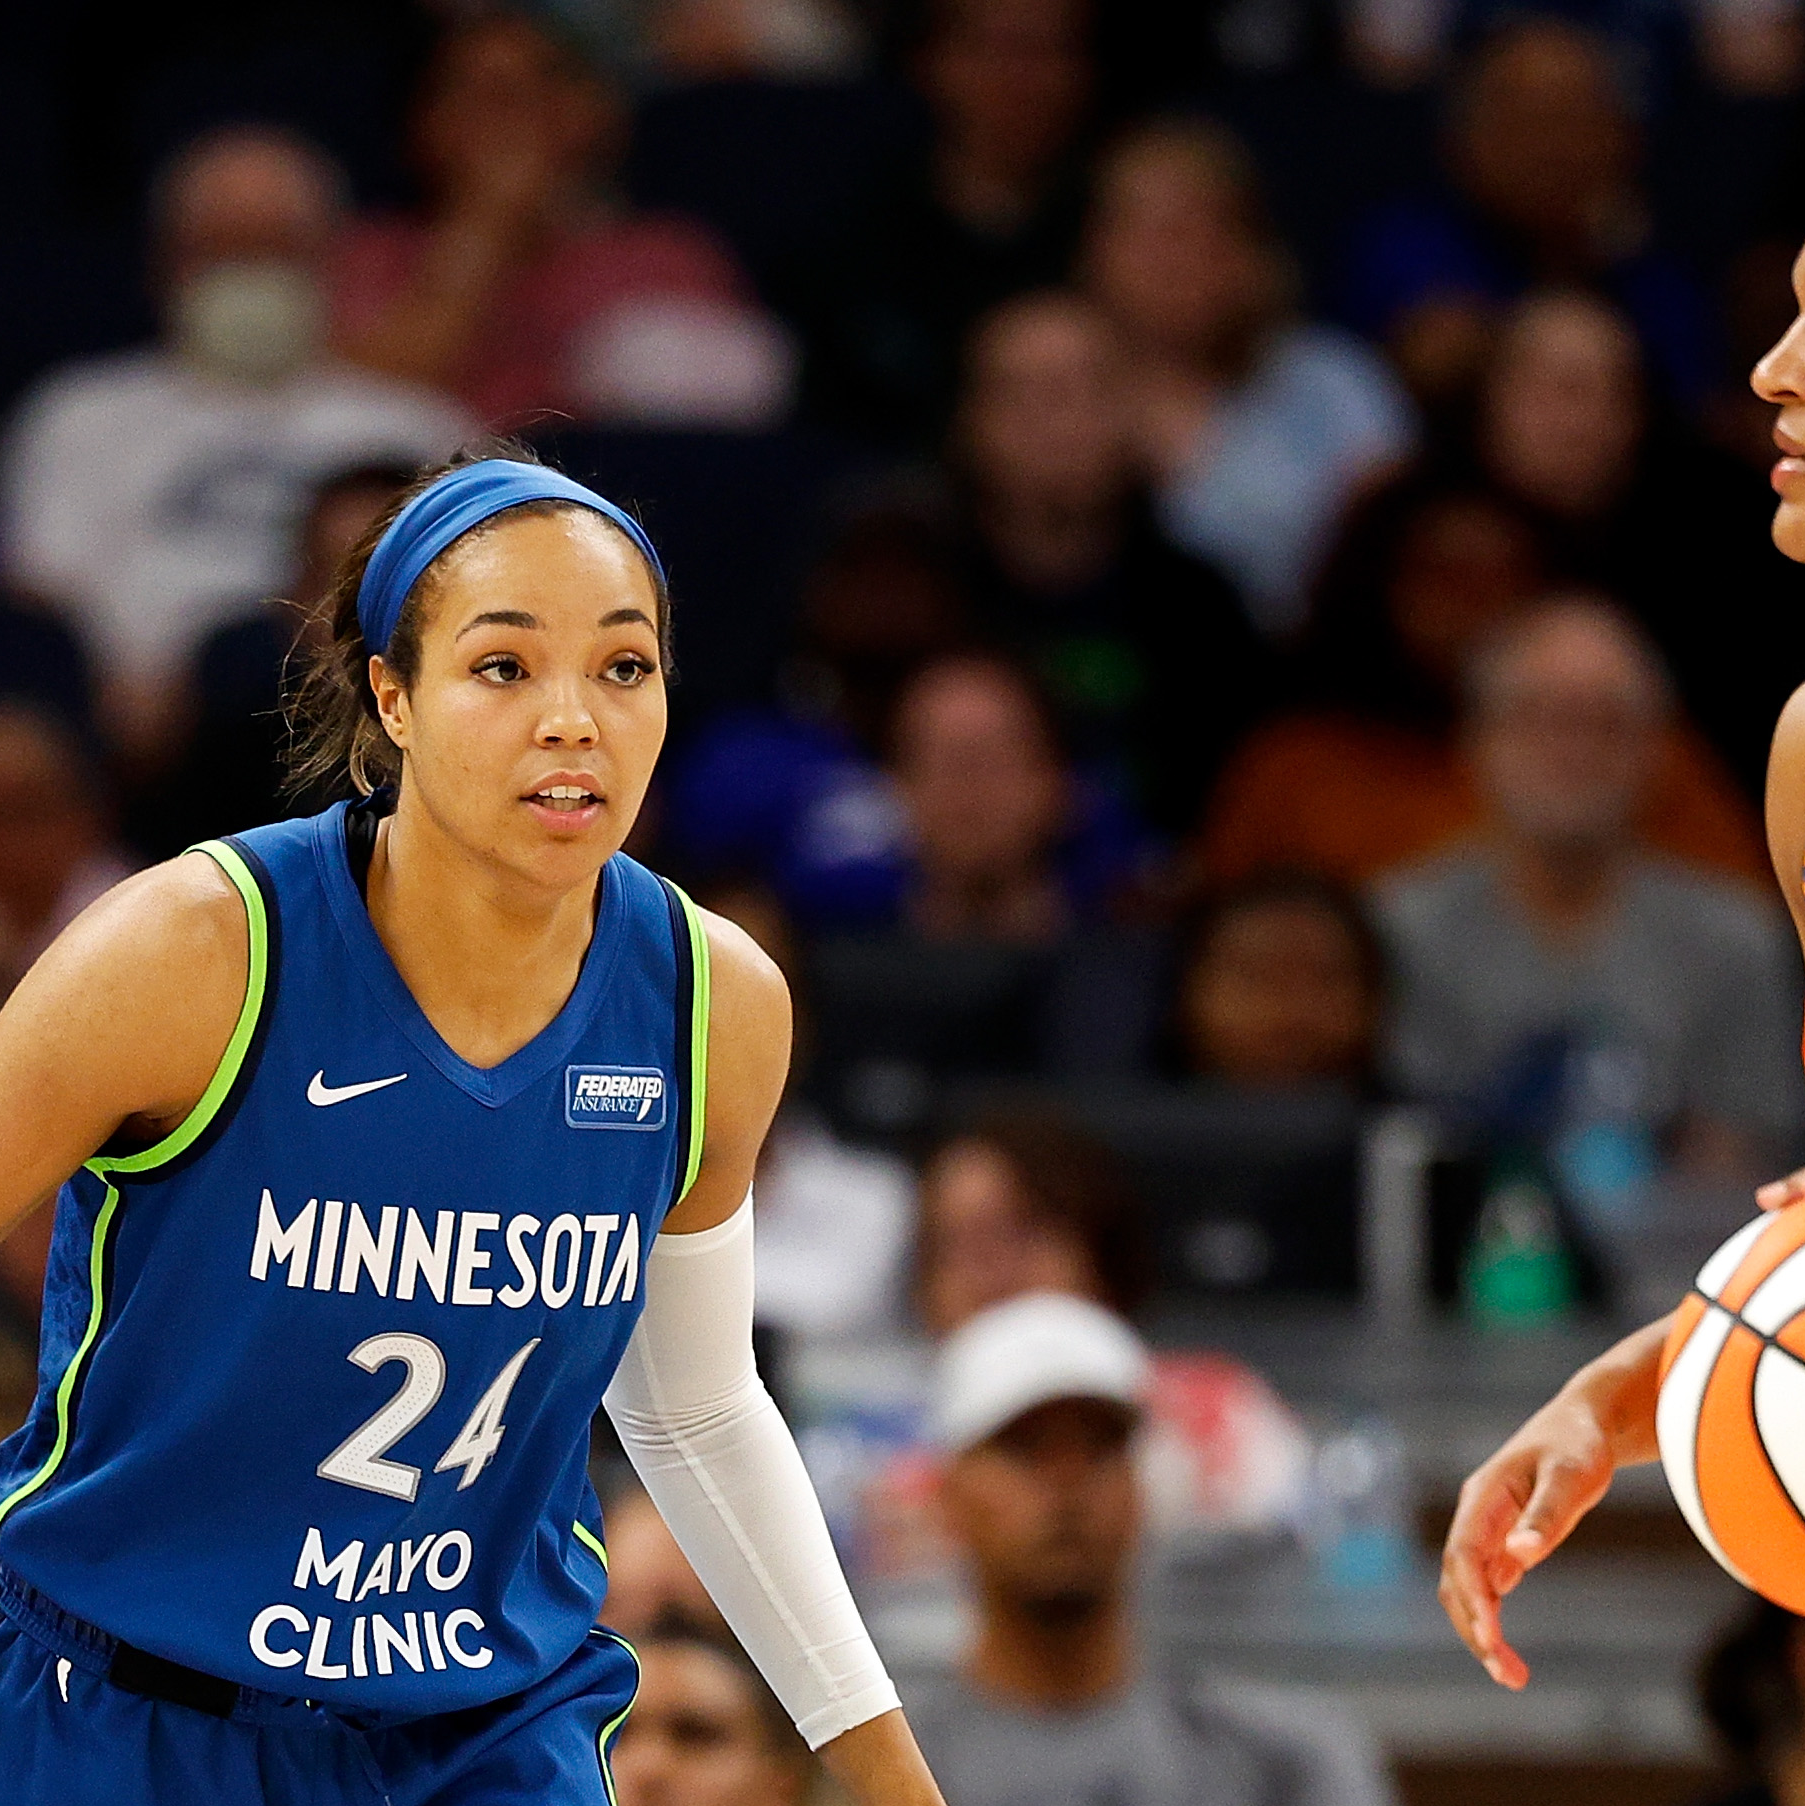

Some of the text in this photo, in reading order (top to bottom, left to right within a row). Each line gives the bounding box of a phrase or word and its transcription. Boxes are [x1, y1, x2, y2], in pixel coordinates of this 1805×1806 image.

[572, 1096, 640, 1112] INSURANCE
[576, 1074, 662, 1098] FEDERATED
[250, 1188, 642, 1309] MINNESOTA
[316, 1331, 542, 1503] 24
[294, 1527, 472, 1603] MAYO
[249, 1604, 493, 1680] CLINIC
